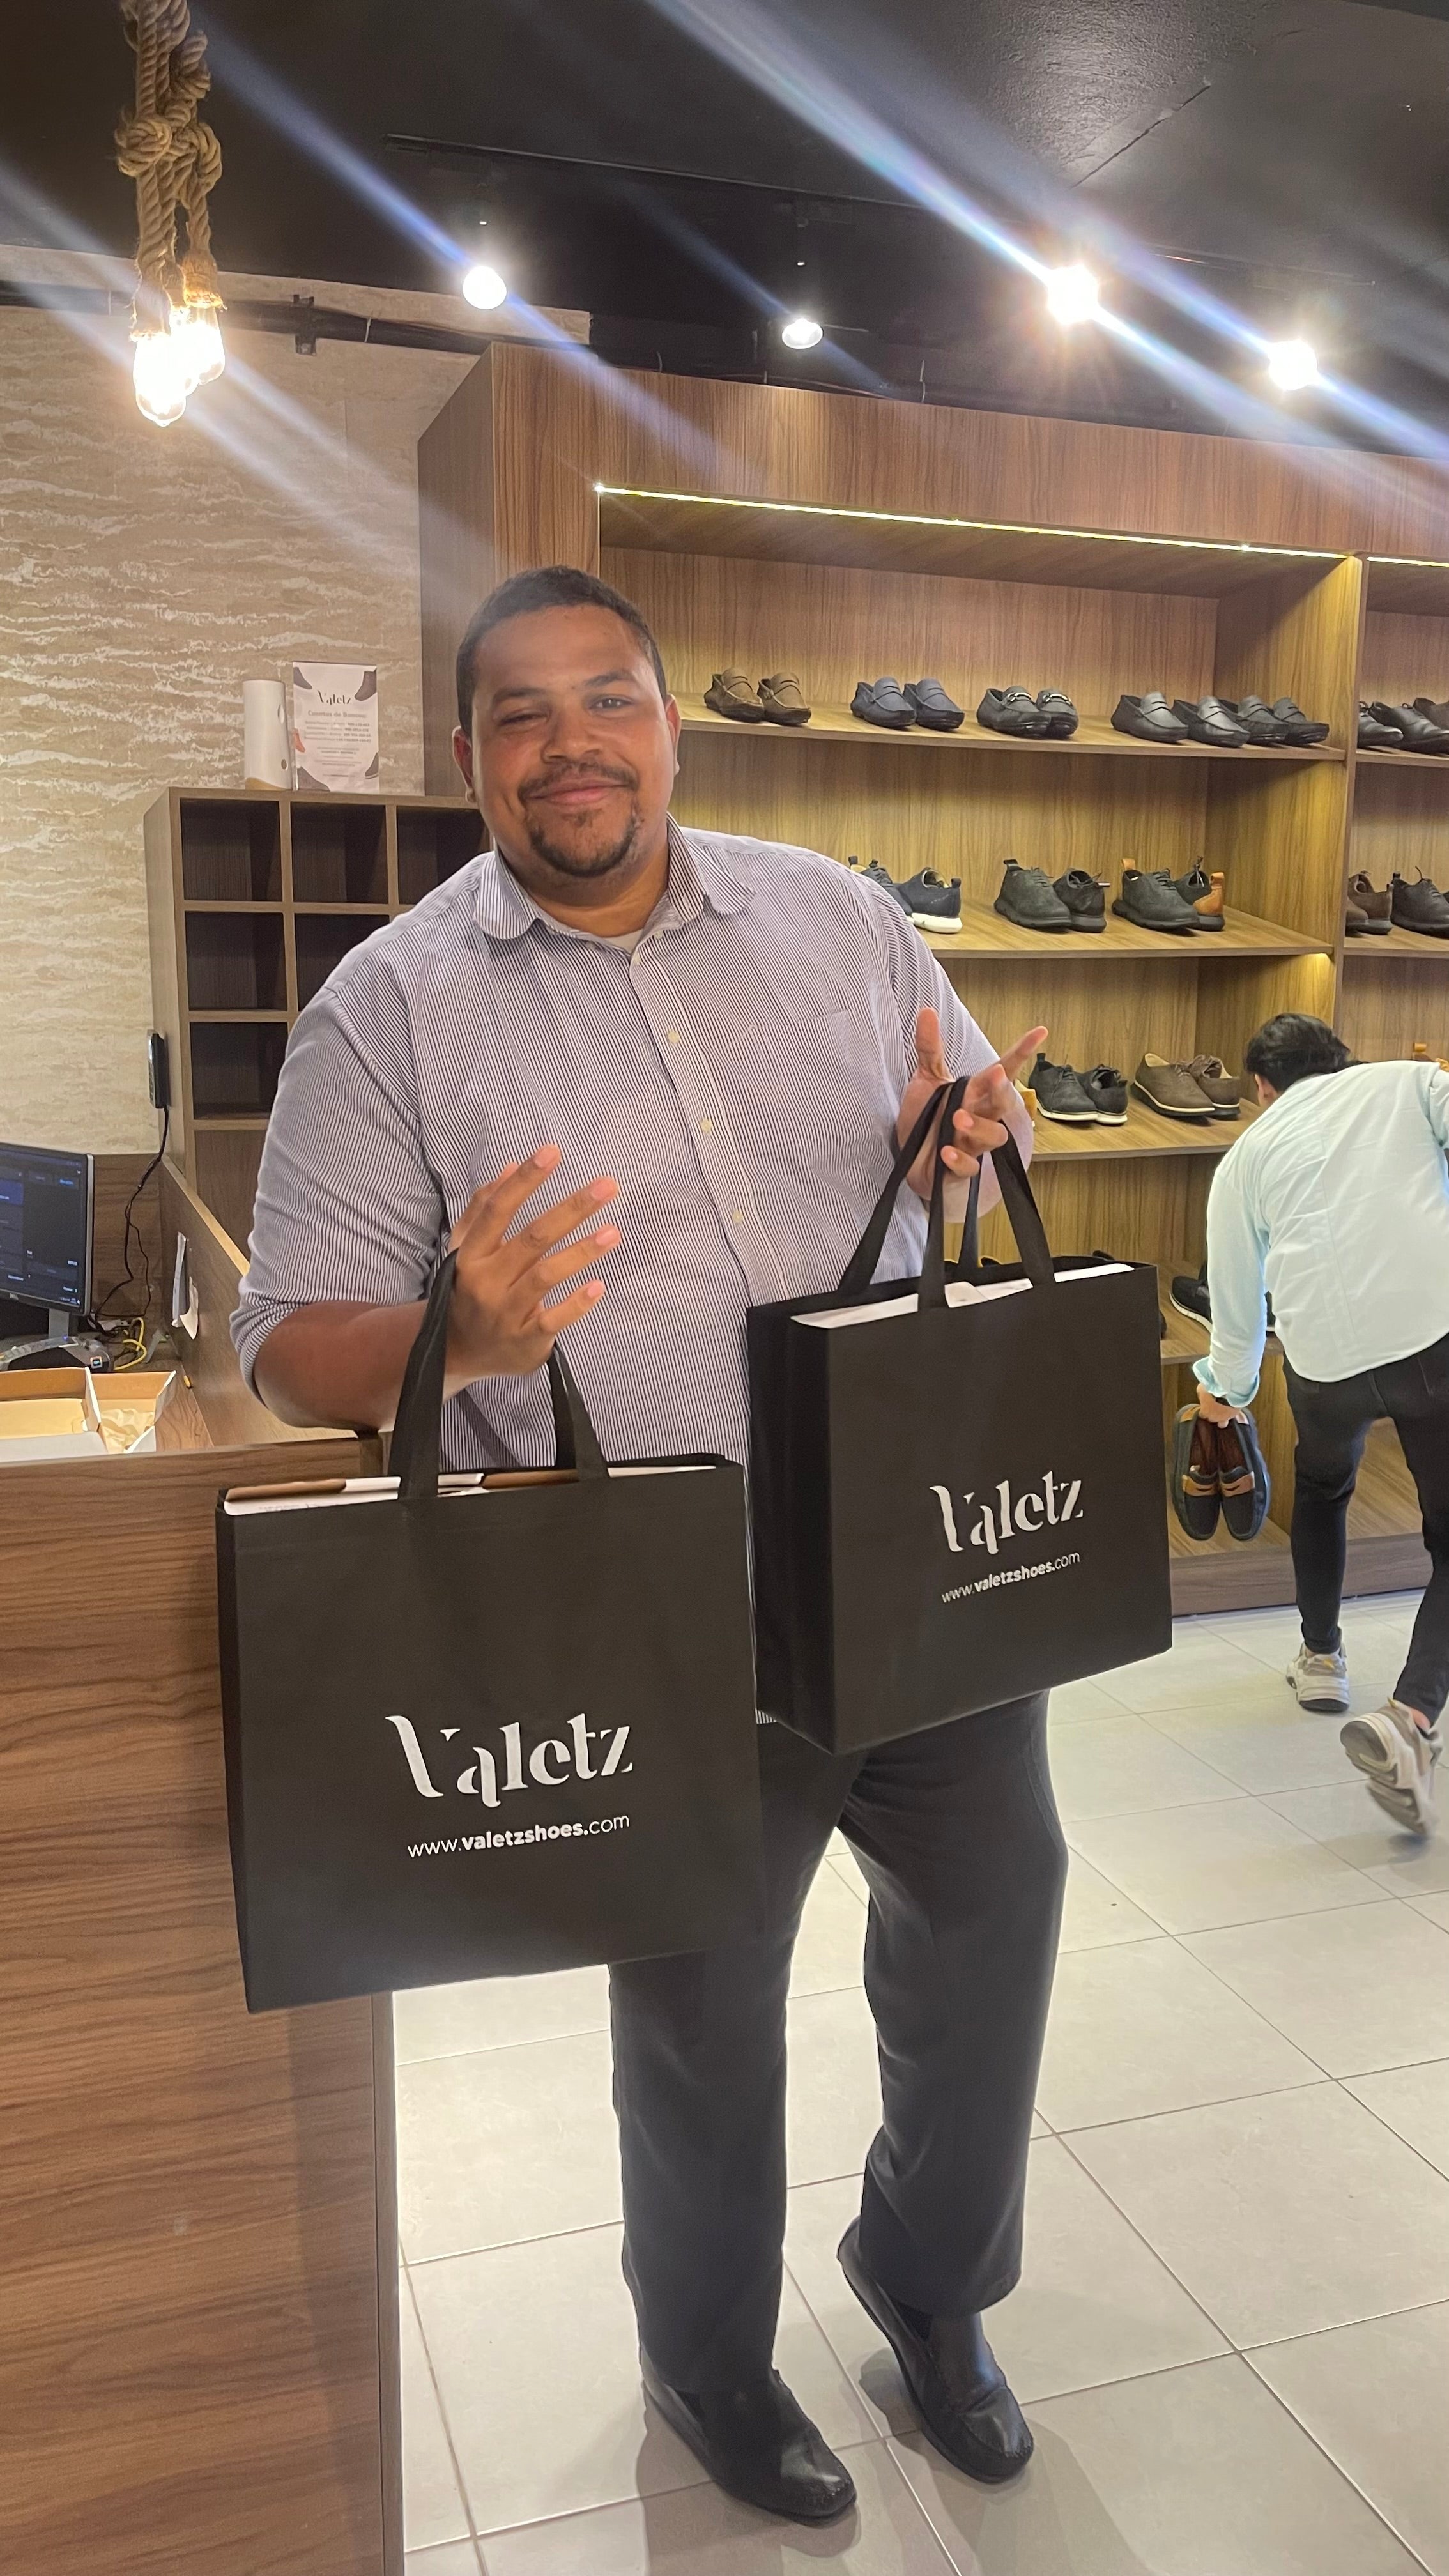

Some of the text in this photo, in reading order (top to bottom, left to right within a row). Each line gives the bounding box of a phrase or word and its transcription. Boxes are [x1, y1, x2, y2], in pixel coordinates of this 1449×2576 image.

[318, 690, 351, 705] Valetz
[930, 1471, 1084, 1554] Valetz
[942, 1552, 1080, 1603] www.valetzshoes.com
[385, 1713, 632, 1808] Valetz
[408, 1815, 630, 1858] www.valetzshoes.com
